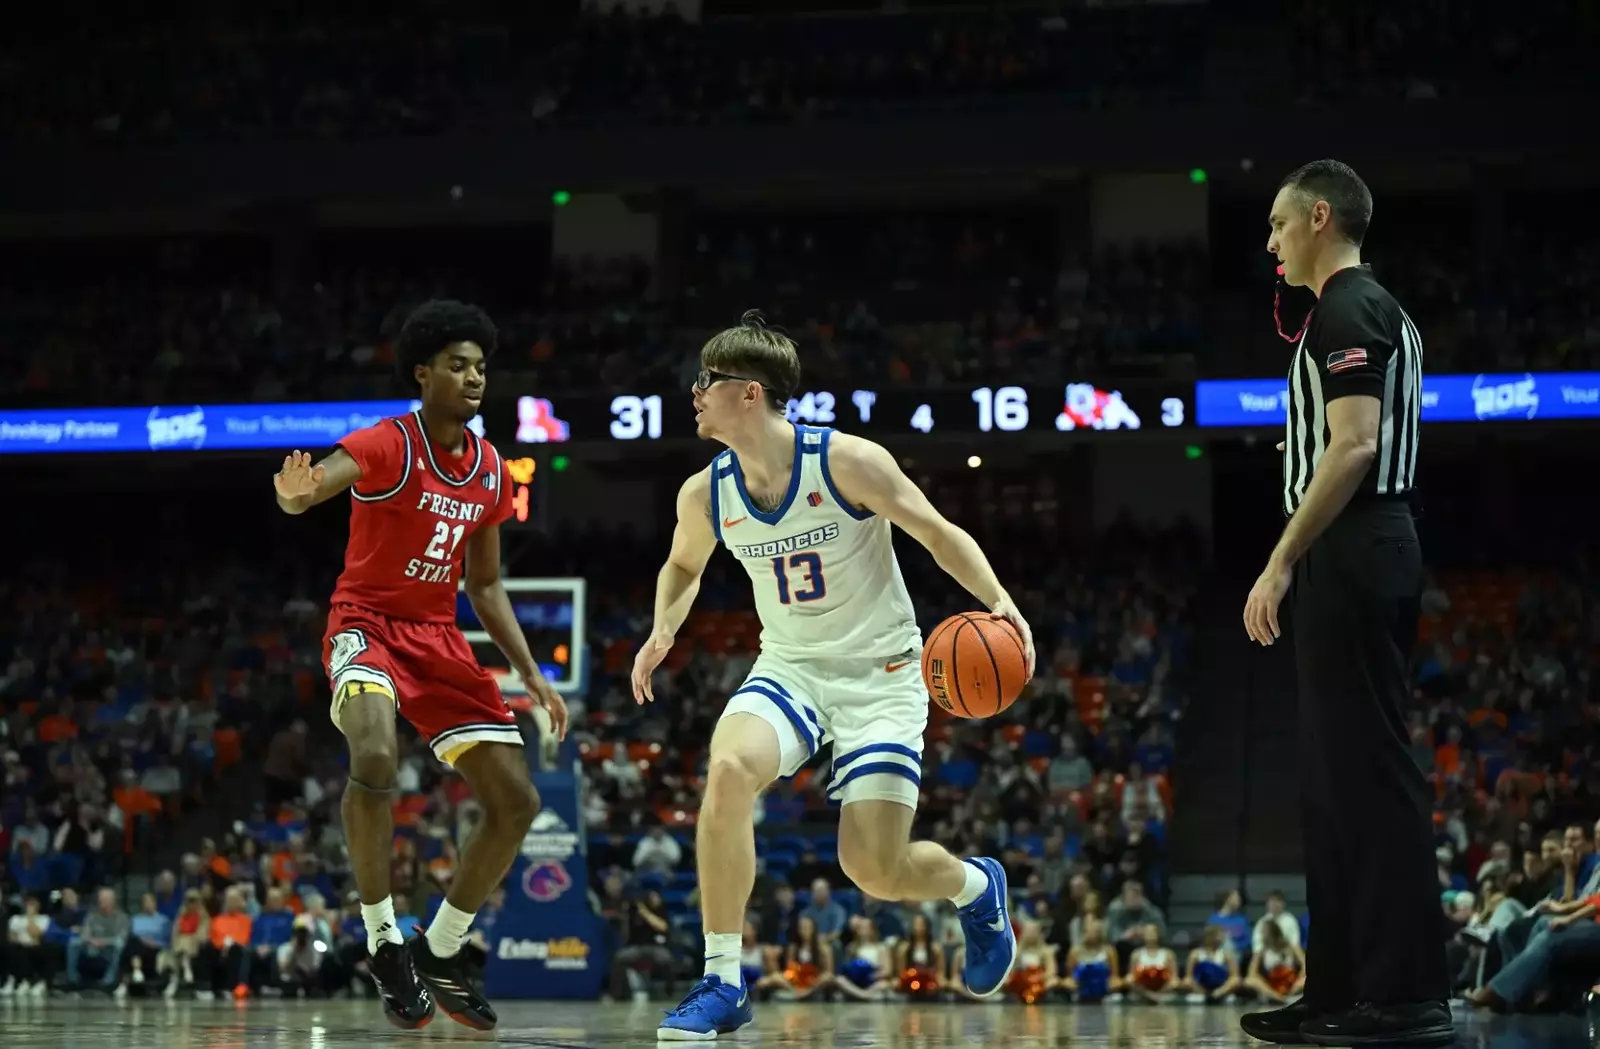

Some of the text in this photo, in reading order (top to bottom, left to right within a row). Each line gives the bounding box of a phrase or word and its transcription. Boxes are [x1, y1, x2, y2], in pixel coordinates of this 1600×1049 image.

[610, 394, 662, 439] 31
[910, 404, 934, 433] 4
[972, 386, 1029, 431] 16
[1161, 398, 1184, 427] 3
[416, 491, 484, 523] FRESNO
[423, 520, 465, 561] 21
[735, 522, 840, 558] BRONCOS
[769, 551, 827, 605] 13
[931, 658, 954, 710] ELITE
